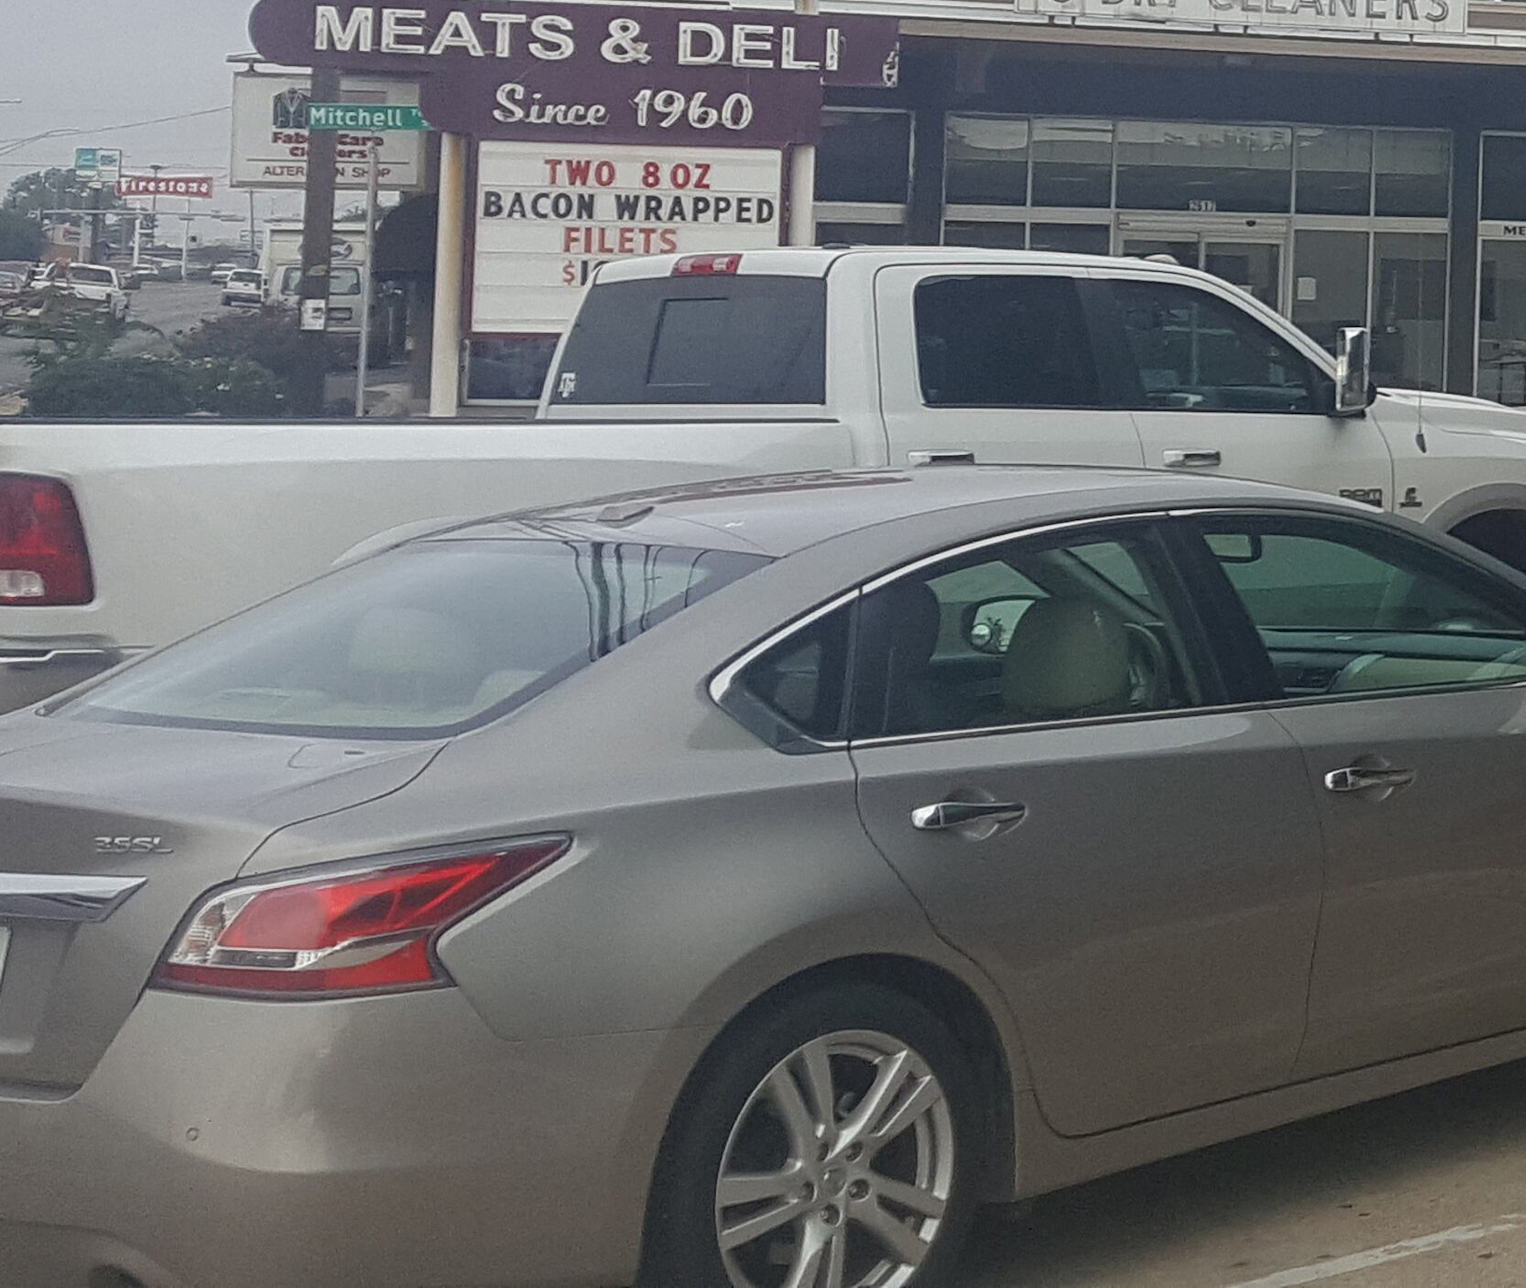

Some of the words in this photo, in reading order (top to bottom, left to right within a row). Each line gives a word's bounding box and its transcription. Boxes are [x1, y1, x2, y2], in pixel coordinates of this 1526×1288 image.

[313, 4, 575, 60] MEATS
[600, 18, 652, 65] &
[677, 21, 840, 71] DELI
[310, 106, 403, 127] Mitchell
[492, 82, 609, 127] Since
[634, 88, 754, 131] 1960
[263, 165, 346, 177] ALTERN
[544, 158, 616, 189] TWO
[119, 177, 209, 195] Firestone
[483, 190, 595, 220] BACON
[615, 193, 774, 224] WRAPPED
[563, 226, 678, 254] FILETS
